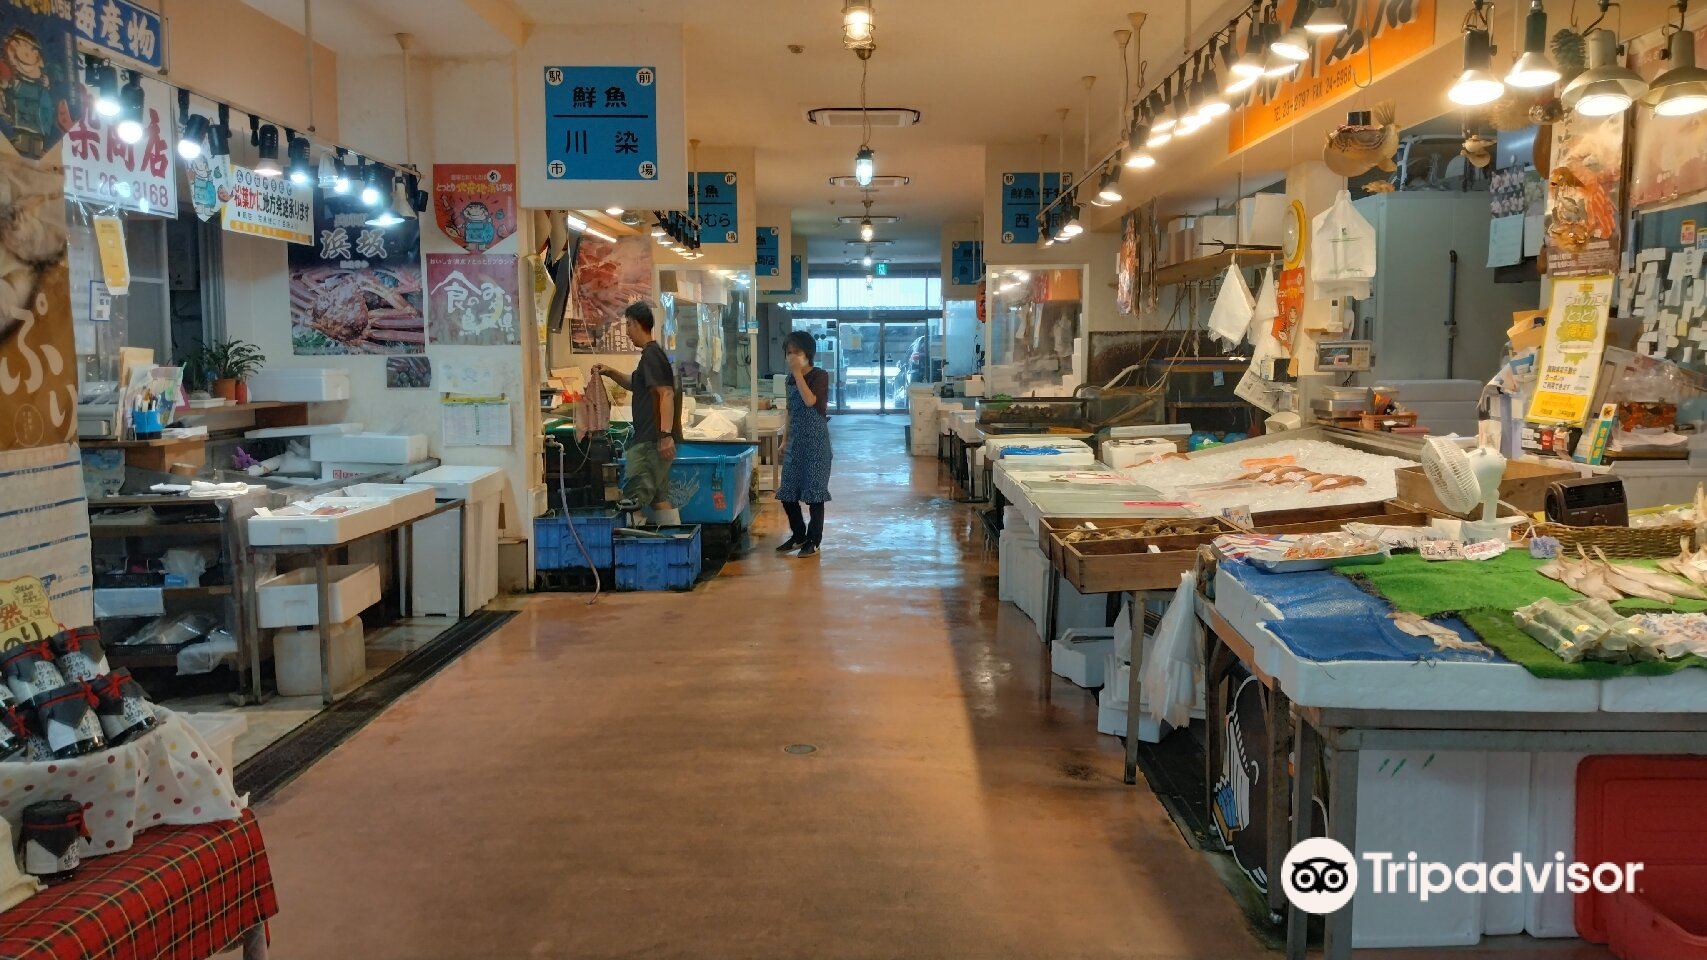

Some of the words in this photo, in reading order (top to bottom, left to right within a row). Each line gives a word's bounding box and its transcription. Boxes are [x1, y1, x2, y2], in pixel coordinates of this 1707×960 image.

[548, 70, 562, 83] 駅
[638, 71, 651, 83] 前
[572, 86, 628, 109] 鮮魚
[565, 129, 639, 155] 川染
[550, 162, 563, 175] 市
[640, 163, 654, 176] 場
